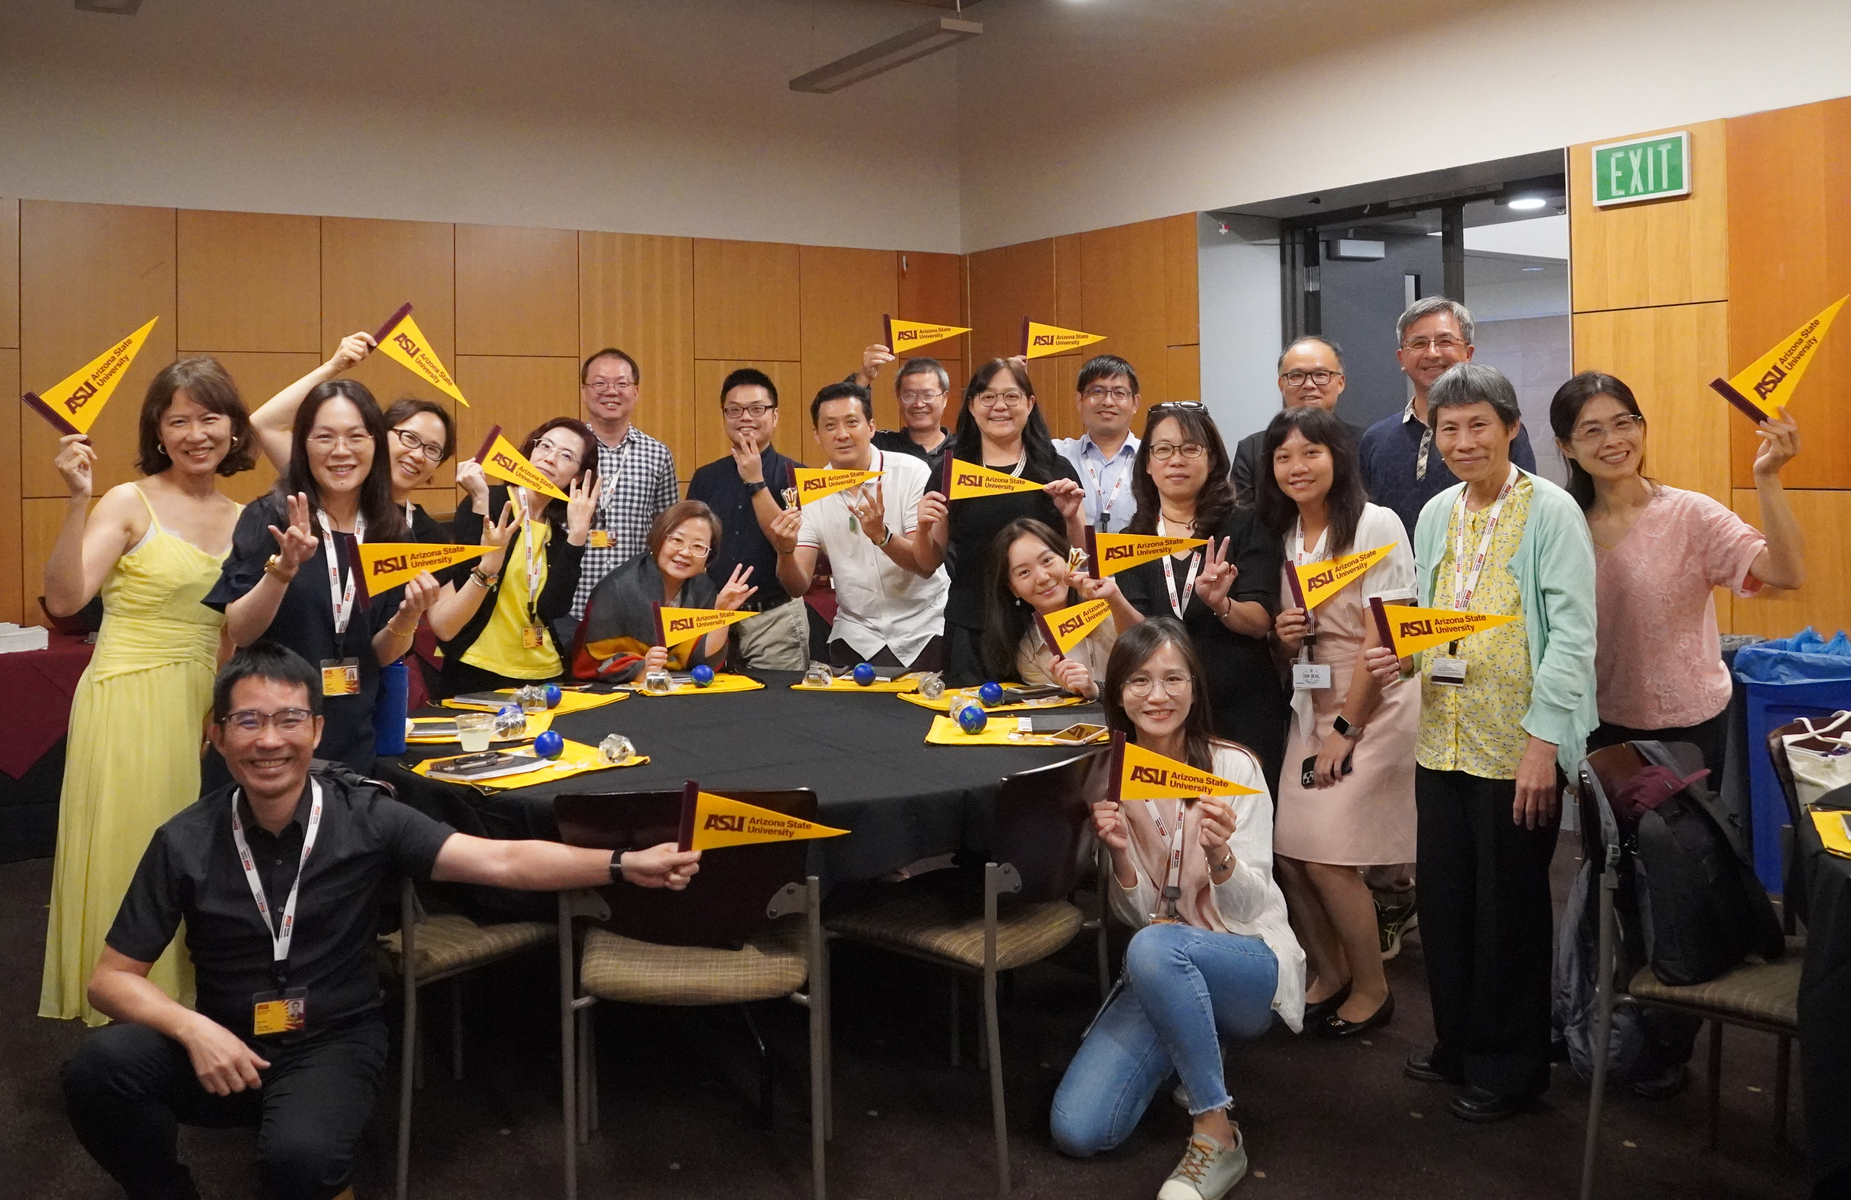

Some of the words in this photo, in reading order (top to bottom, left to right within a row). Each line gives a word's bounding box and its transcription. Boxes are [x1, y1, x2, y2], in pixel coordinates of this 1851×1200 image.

[1611, 143, 1671, 196] EXIT
[898, 330, 917, 340] ASU
[1033, 335, 1054, 346] ASU
[1779, 337, 1804, 365] Arizona
[1800, 319, 1820, 338] State
[393, 332, 420, 358] ASU
[1785, 336, 1818, 370] University
[91, 355, 116, 380] Arizona
[113, 338, 132, 357] State
[96, 354, 129, 386] University
[415, 357, 440, 383] University
[420, 353, 439, 373] Arizona
[440, 369, 453, 386] State
[1753, 364, 1787, 401] ASU
[64, 379, 98, 415] ASU
[491, 452, 518, 473] ASU
[515, 471, 542, 490] University
[519, 466, 540, 481] Arizona
[540, 477, 554, 489] State
[804, 477, 826, 491] ASU
[828, 479, 856, 487] University
[957, 474, 982, 487] ASU
[985, 482, 1015, 491] University
[410, 550, 442, 560] Arizona
[443, 546, 465, 555] State
[1105, 545, 1134, 561] ASU
[1136, 541, 1164, 549] Arizona
[1136, 547, 1172, 556] University
[373, 555, 408, 576] ASU
[411, 555, 452, 568] University
[1335, 559, 1359, 573] Arizona
[1360, 550, 1377, 561] State
[1336, 562, 1368, 579] University
[1307, 569, 1334, 592] ASU
[1083, 602, 1105, 617] Arizona
[670, 618, 694, 632] ASU
[696, 619, 726, 628] University
[1058, 614, 1085, 637] ASU
[1400, 619, 1434, 638] ASU
[1434, 616, 1465, 626] Arizona
[1466, 614, 1486, 622] State
[1435, 624, 1475, 634] University
[1130, 765, 1167, 786] ASU
[1170, 771, 1204, 783] Arizona
[1205, 777, 1229, 788] State
[1170, 780, 1213, 794] University
[703, 814, 745, 832] ASU
[749, 817, 786, 828] Arizona
[787, 820, 812, 830] State
[747, 826, 795, 838] University
